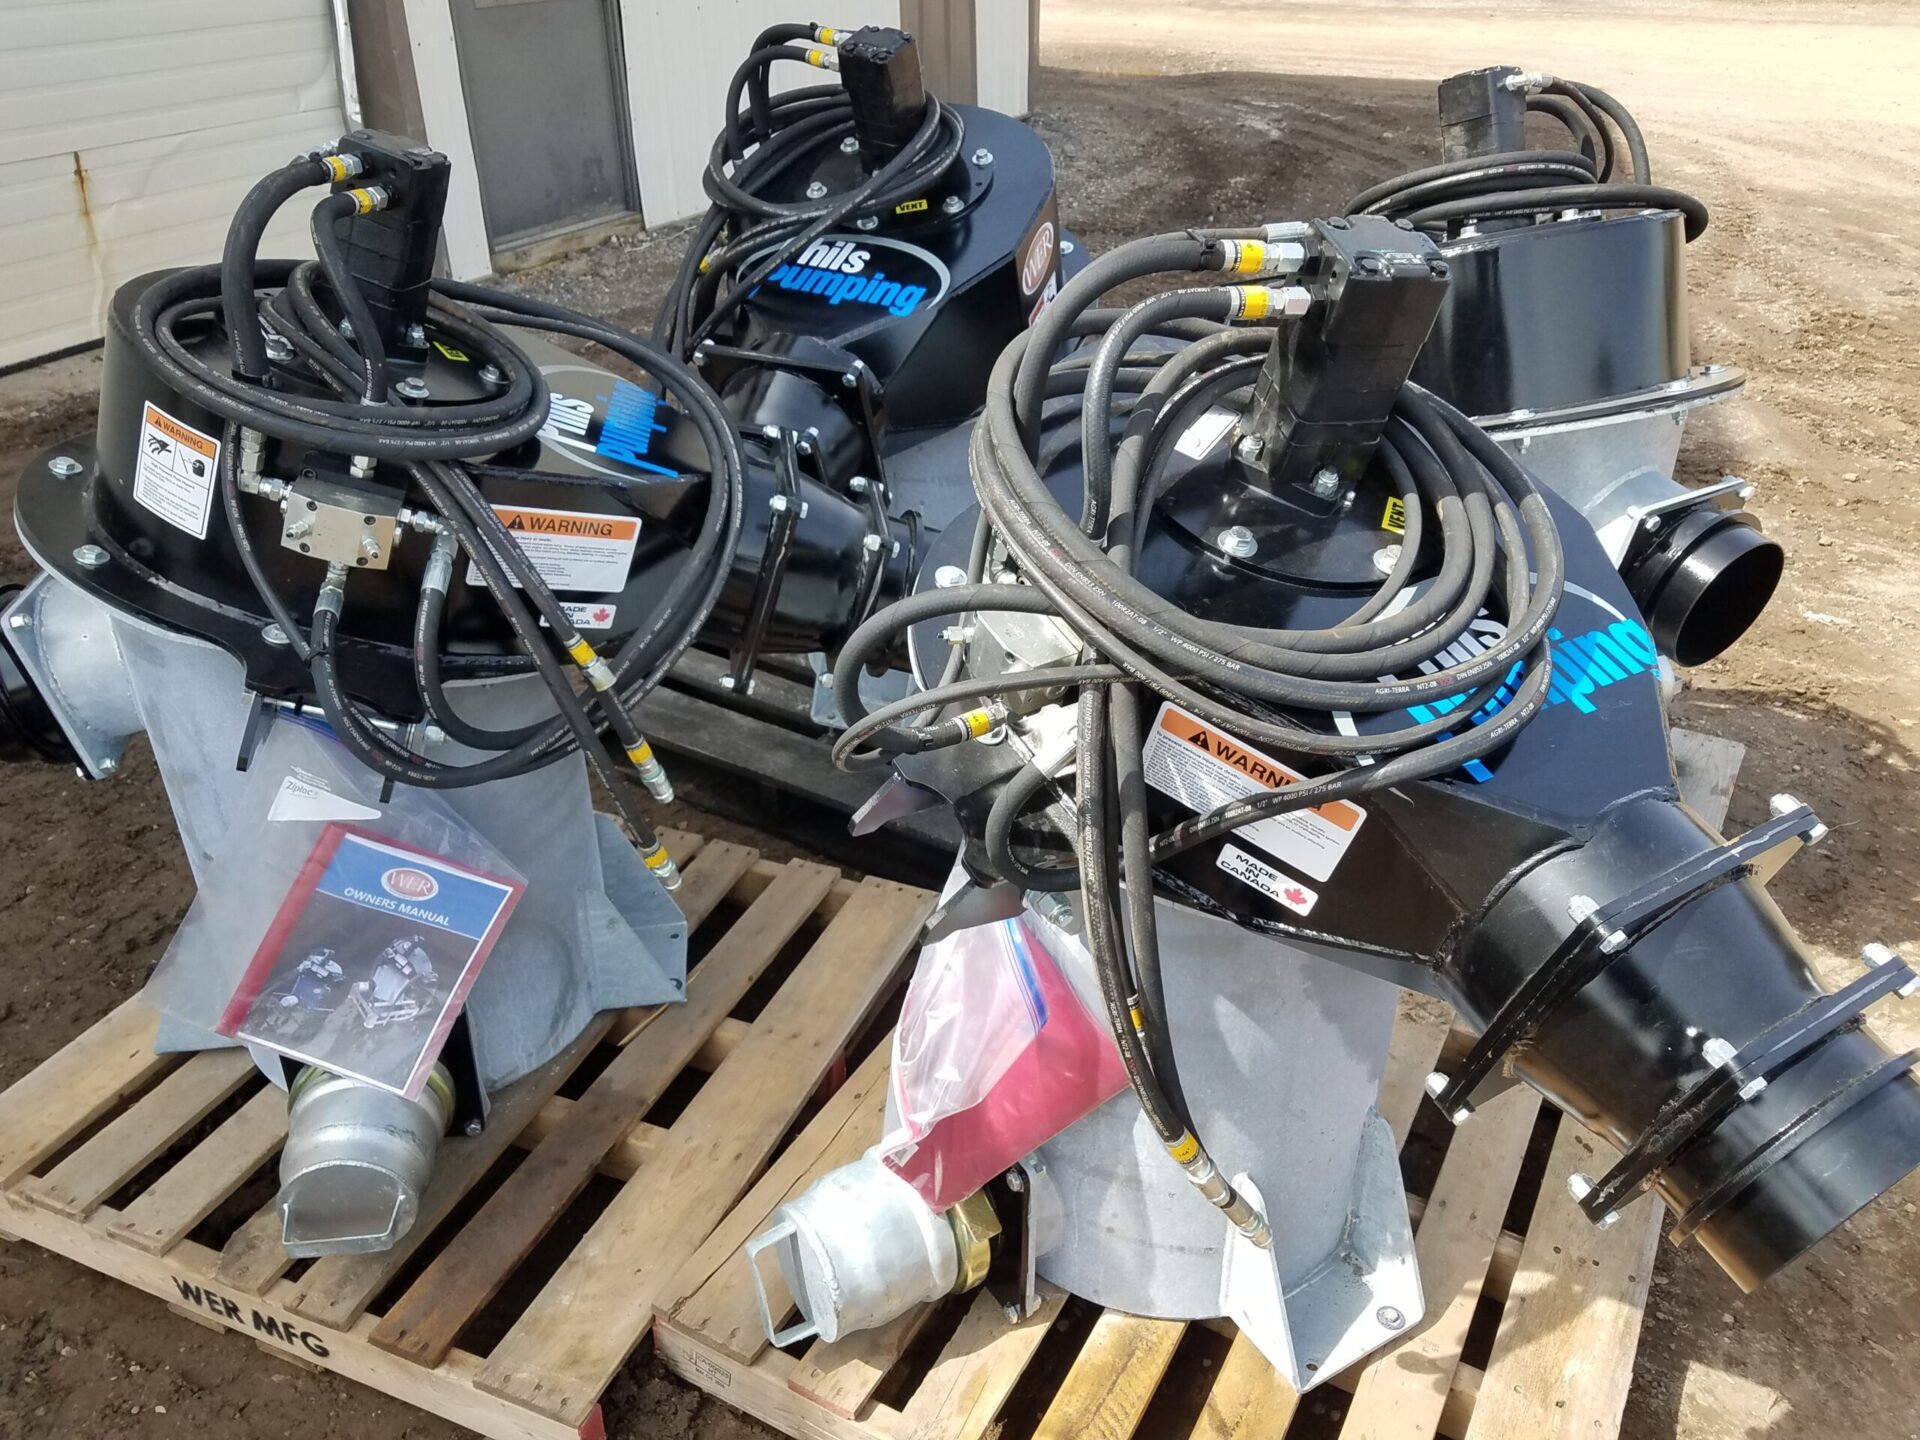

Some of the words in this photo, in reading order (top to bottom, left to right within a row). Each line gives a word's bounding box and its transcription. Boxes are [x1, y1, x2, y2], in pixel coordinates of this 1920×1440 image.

[900, 201, 924, 212] VENT
[797, 237, 871, 274] hils
[163, 422, 204, 450] WARNING
[529, 516, 613, 537] WARNING
[563, 605, 588, 613] ADE
[1111, 600, 1148, 626] 100R2AT-08
[1182, 641, 1200, 655] 4000
[1225, 660, 1241, 672] BAR
[1375, 686, 1410, 695] AGRI-TERRA
[1416, 682, 1437, 691] NT2-08
[1490, 717, 1518, 739] AGRI-TERRA
[285, 781, 313, 796] Ziploc
[1257, 799, 1268, 809] 1/2"
[1272, 796, 1284, 804] WP
[1283, 792, 1298, 803] 4000
[1298, 788, 1309, 798] PSI
[1313, 784, 1327, 795] 275
[1327, 781, 1342, 791] BAR
[1220, 860, 1281, 898] CANADA
[1235, 853, 1279, 882] MADE
[1244, 866, 1260, 879] IN
[388, 871, 431, 896] WER
[344, 887, 396, 910] OWNERS
[398, 902, 450, 926] MANUAL
[171, 1275, 246, 1325] WER
[251, 1308, 330, 1358] MFG
